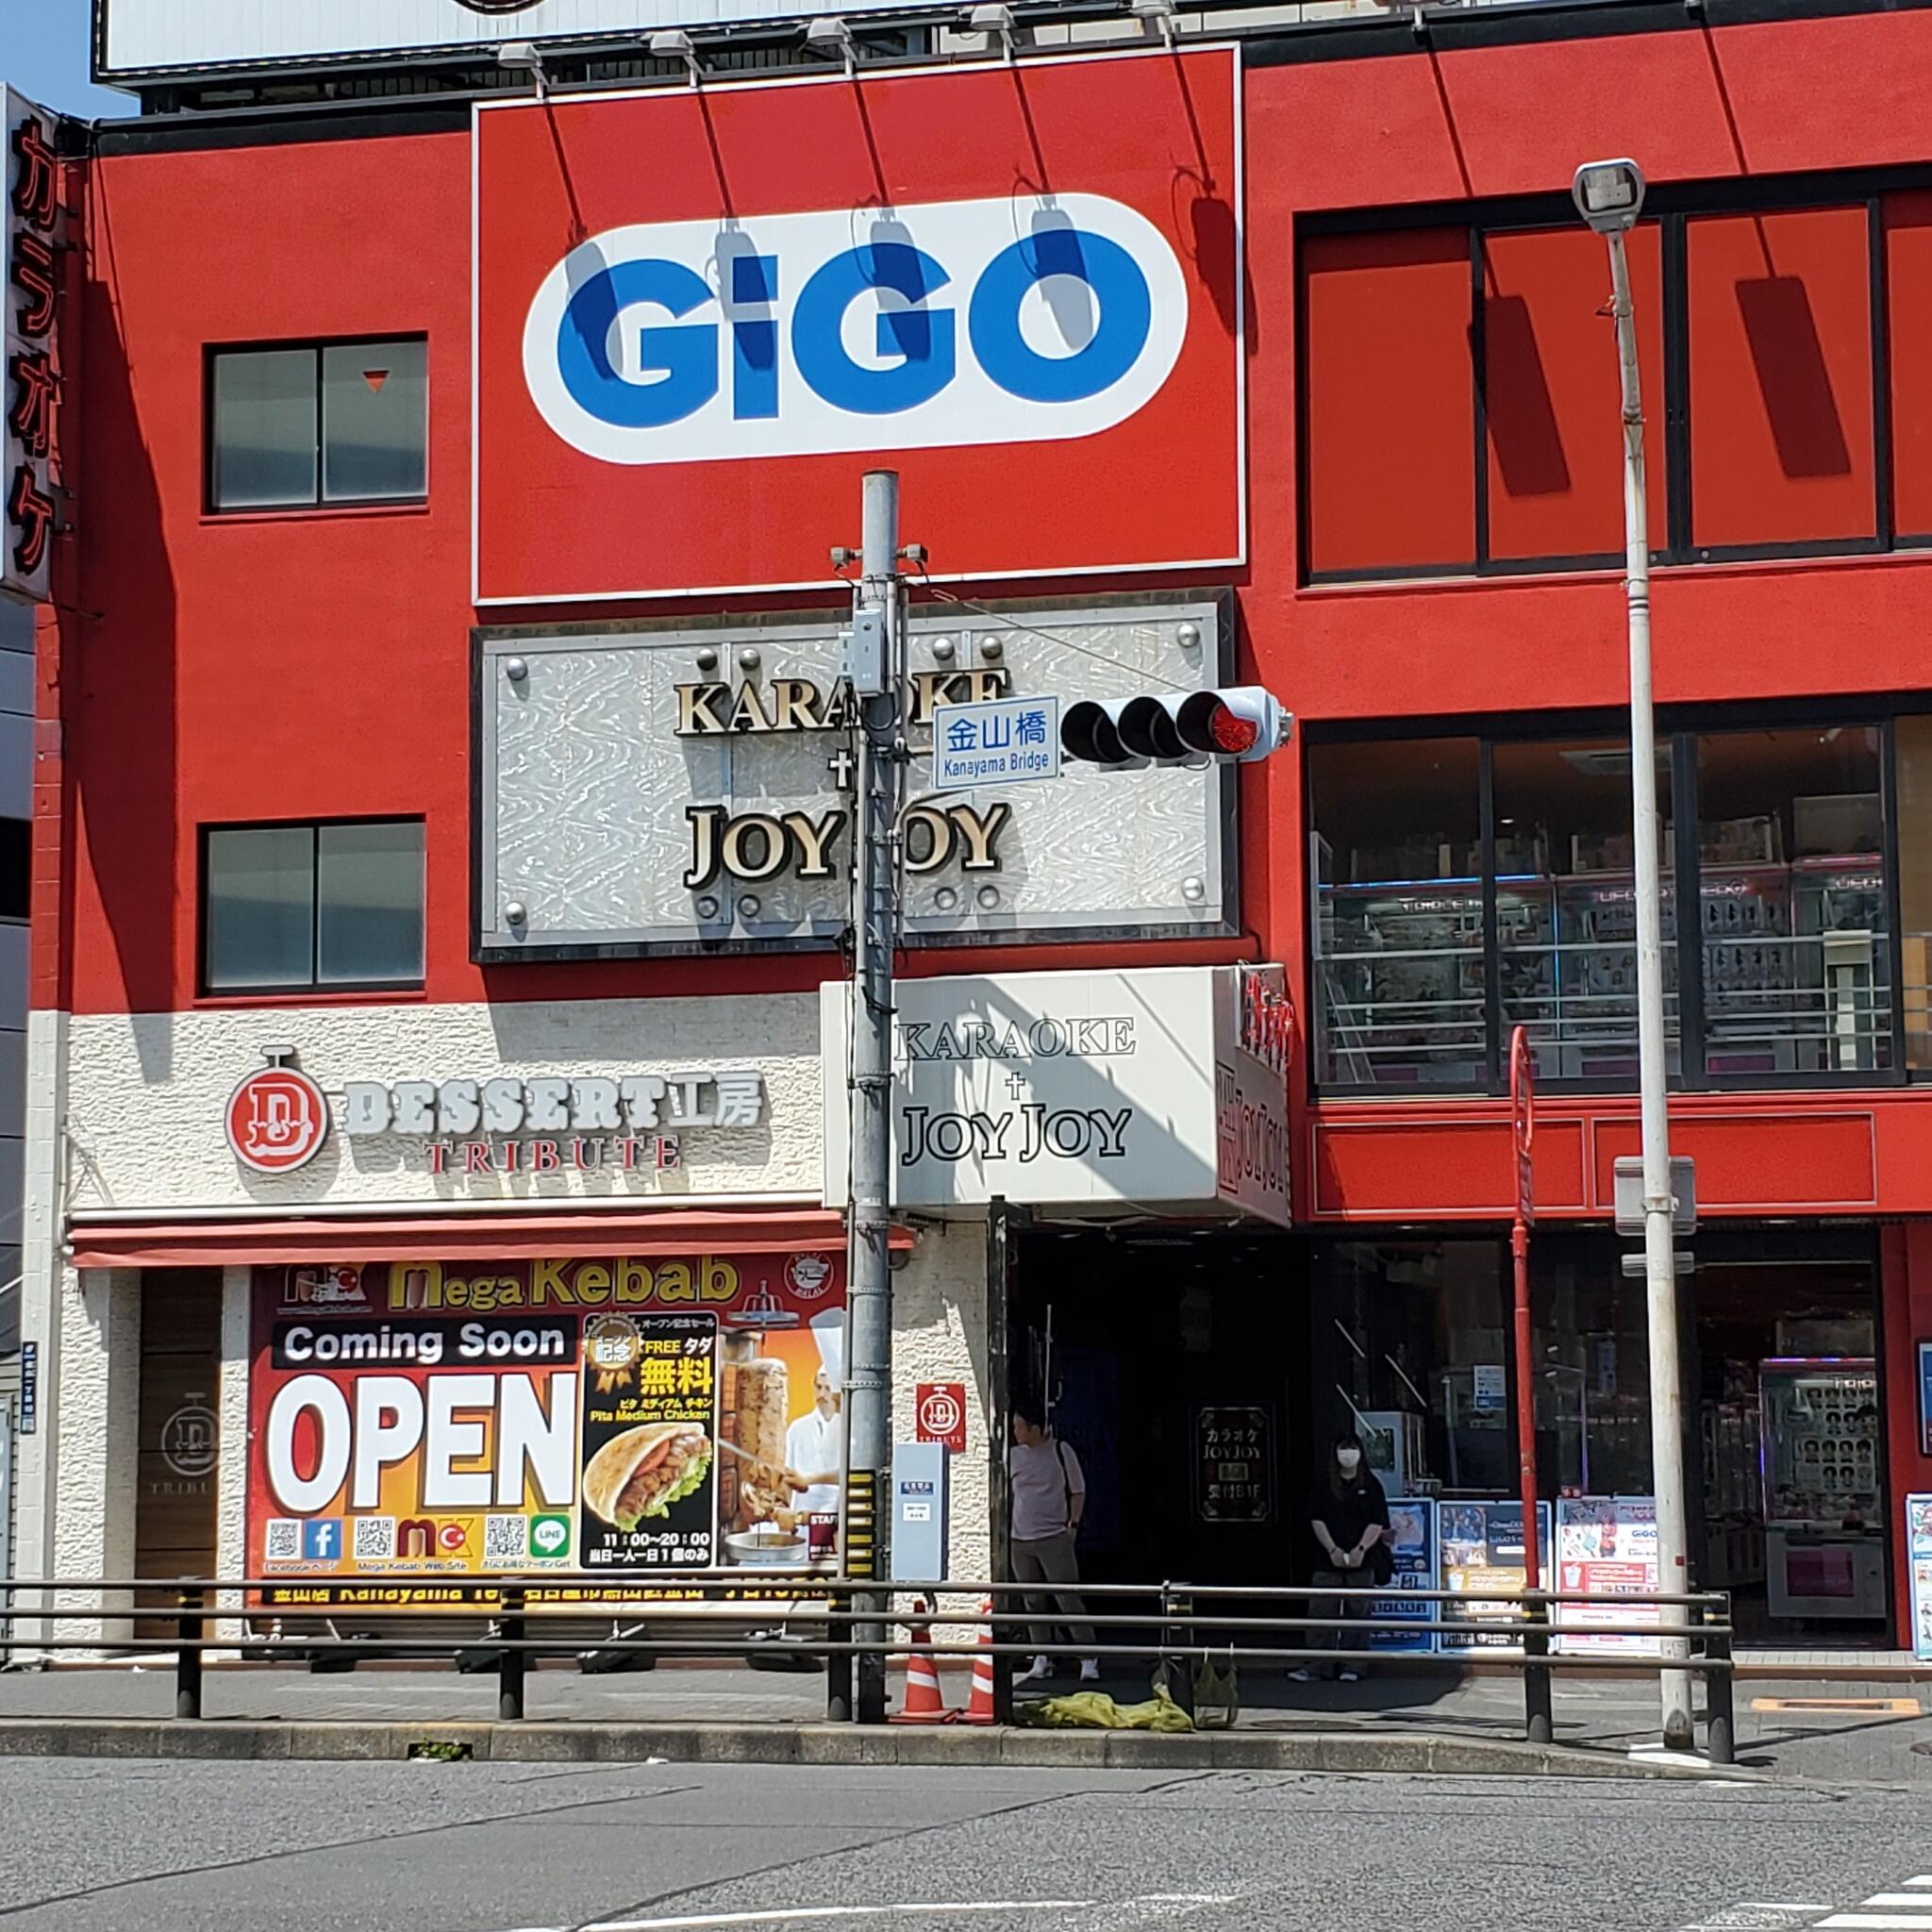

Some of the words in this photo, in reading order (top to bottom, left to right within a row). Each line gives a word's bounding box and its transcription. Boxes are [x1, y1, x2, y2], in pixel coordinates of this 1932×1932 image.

[10, 114, 56, 575] カラオケ
[558, 228, 1152, 428] GiGO
[674, 667, 1011, 736] KARAKE
[947, 710, 1046, 752] 金山橋
[944, 757, 1006, 777] Kanayama
[1010, 751, 1049, 771] Bridge
[684, 803, 1011, 891] JOYOY
[894, 1017, 1136, 1060] KARAOKE
[424, 1135, 681, 1174] TRIBUTE
[530, 1256, 741, 1307] Kebab
[284, 1325, 443, 1365] Coming
[458, 1323, 566, 1357] Soon
[595, 1343, 631, 1363] 記念
[645, 1340, 681, 1354] FREE
[684, 1337, 714, 1356] タダ
[641, 1356, 713, 1395] 無料
[591, 1410, 613, 1422] Pita
[616, 1409, 661, 1421] Medium
[663, 1408, 710, 1420] Chicken
[1207, 1427, 1259, 1443] カラオケ
[267, 1372, 577, 1513] OPEN
[540, 1528, 561, 1540] LINE
[810, 1514, 838, 1524] STAF
